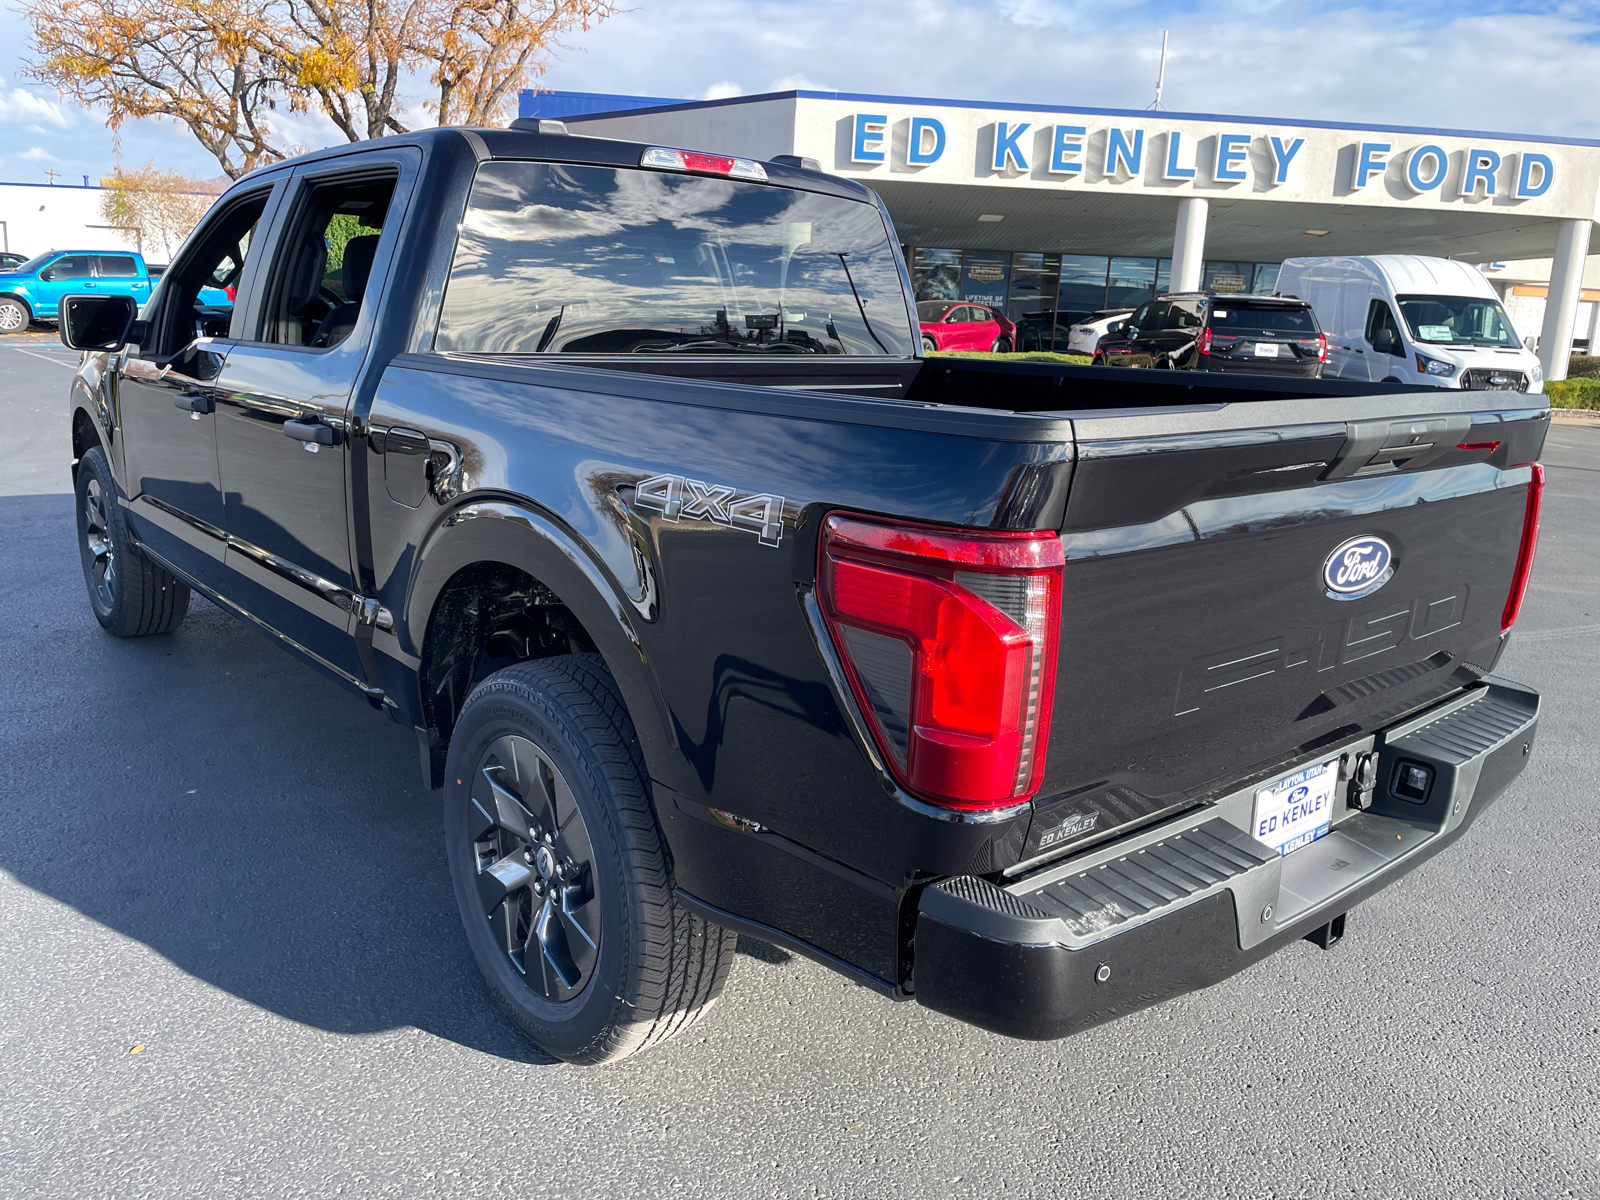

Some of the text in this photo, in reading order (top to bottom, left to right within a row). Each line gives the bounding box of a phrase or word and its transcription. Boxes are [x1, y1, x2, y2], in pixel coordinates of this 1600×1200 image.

[851, 112, 1556, 200] ED KENLEY FORD
[1336, 544, 1383, 585] Ford
[861, 648, 908, 666] FORD
[1174, 582, 1470, 716] F-150
[1306, 763, 1323, 779] UTAH
[1040, 833, 1055, 846] ED
[1056, 816, 1098, 840] KENLEY
[1259, 791, 1331, 836] ED KENLEY
[1283, 829, 1316, 856] KENLEY
